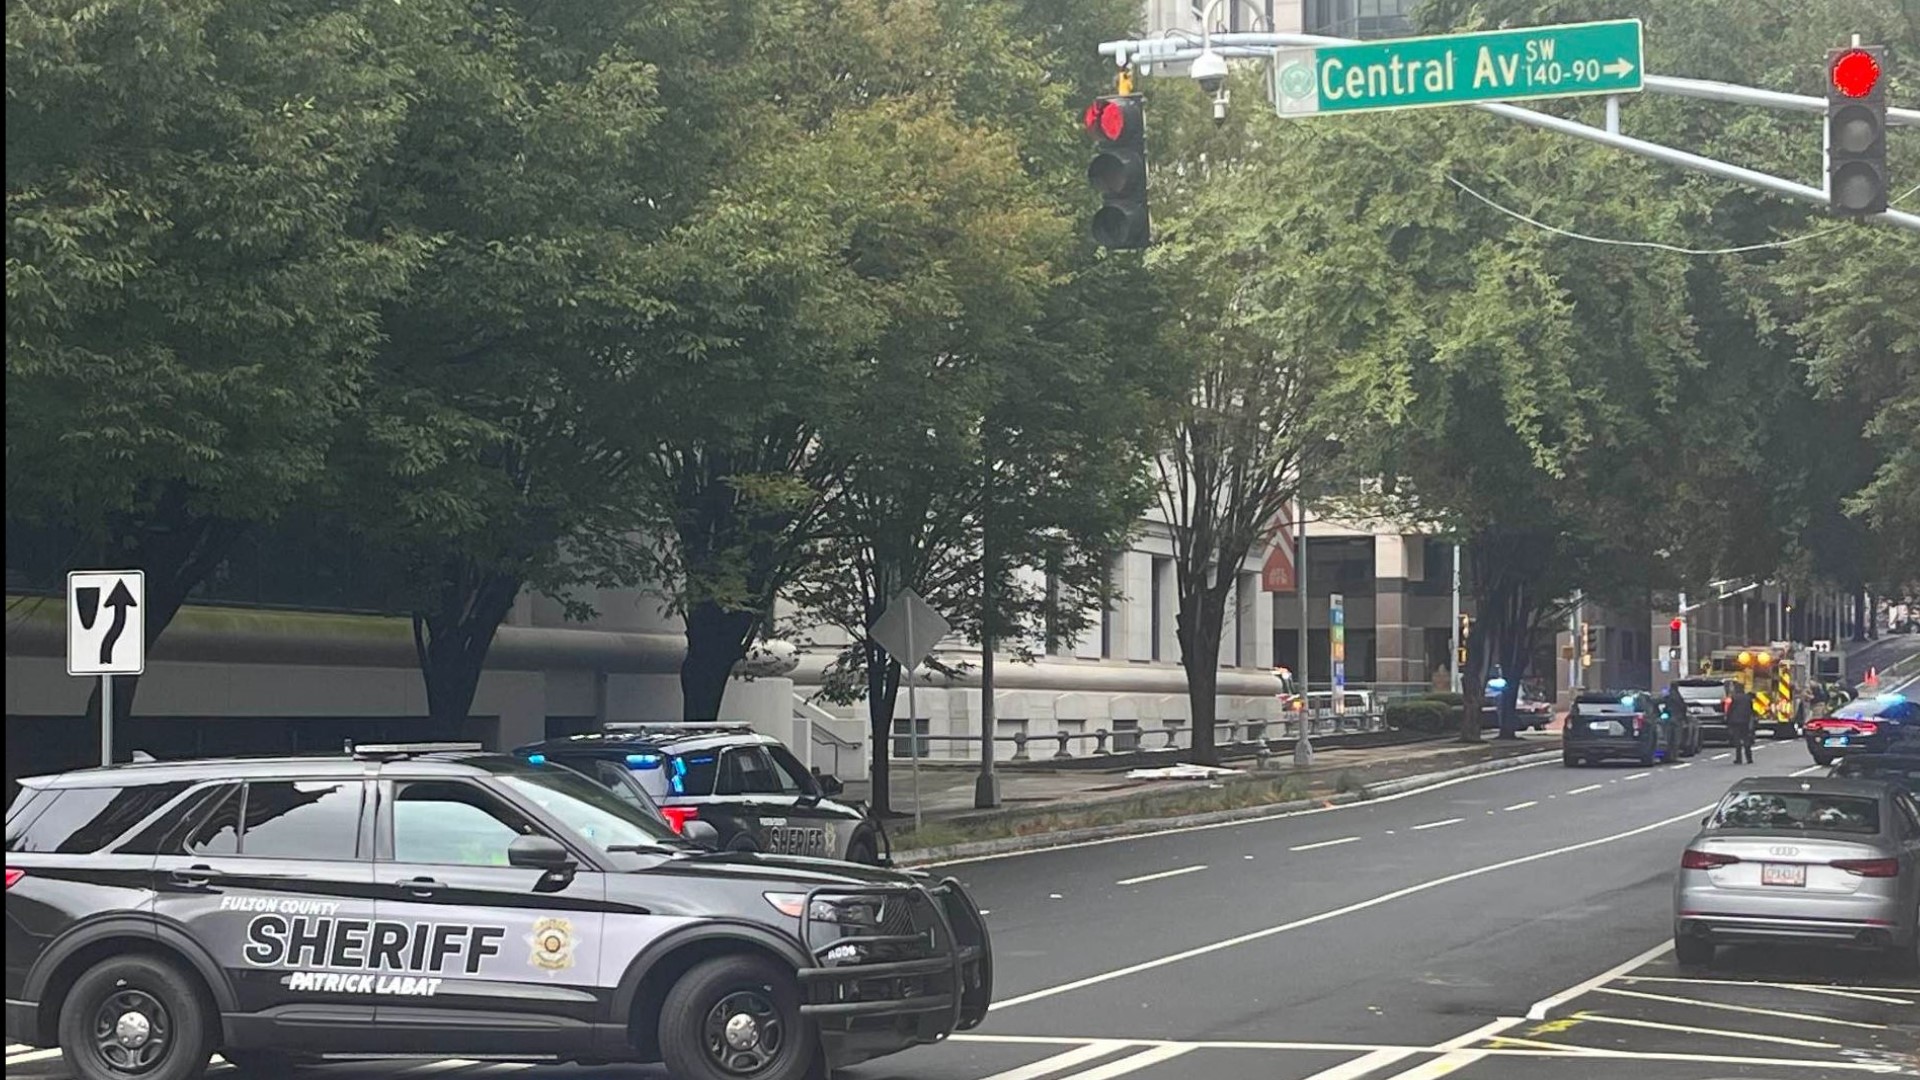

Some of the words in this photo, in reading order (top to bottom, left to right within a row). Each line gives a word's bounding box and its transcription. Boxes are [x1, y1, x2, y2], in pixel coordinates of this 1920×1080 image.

[1525, 38, 1555, 62] SW
[1321, 49, 1454, 100] Central
[1473, 46, 1519, 88] Av
[1525, 60, 1600, 86] 140-90
[220, 895, 278, 914] FULTON
[280, 898, 340, 916] COUNTY
[243, 914, 505, 976] SHERIFF
[288, 972, 374, 995] PATRICK
[374, 976, 442, 997] LABAT
